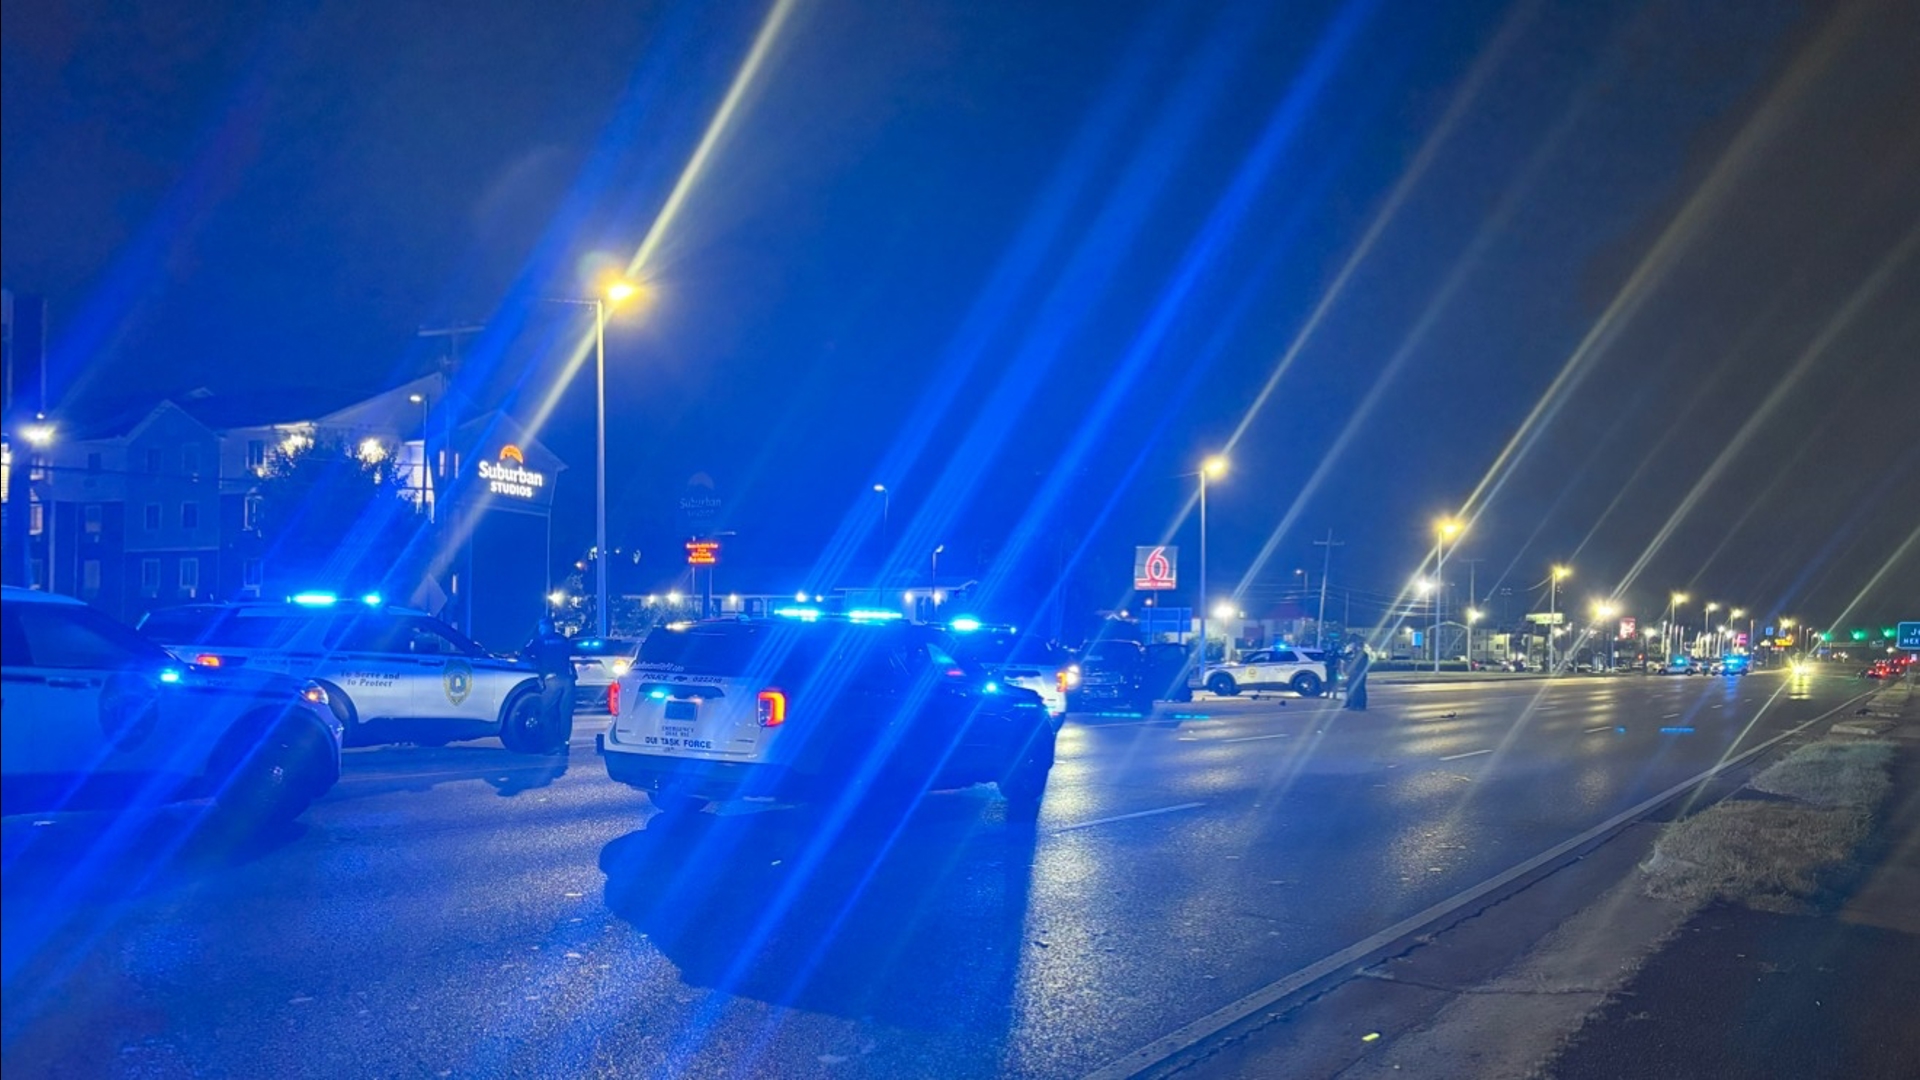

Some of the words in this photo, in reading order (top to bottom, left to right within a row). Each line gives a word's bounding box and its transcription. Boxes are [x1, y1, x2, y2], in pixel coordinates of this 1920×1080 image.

[478, 460, 543, 487] Suburban
[490, 481, 533, 498] STUDIOS
[679, 496, 722, 509] Suburban
[1145, 546, 1169, 580] 6
[355, 671, 380, 679] Serve
[383, 671, 400, 680] and
[359, 679, 393, 687] Protect
[645, 736, 658, 744] DUI
[660, 737, 681, 746] TASK
[683, 739, 712, 749] FORCE
